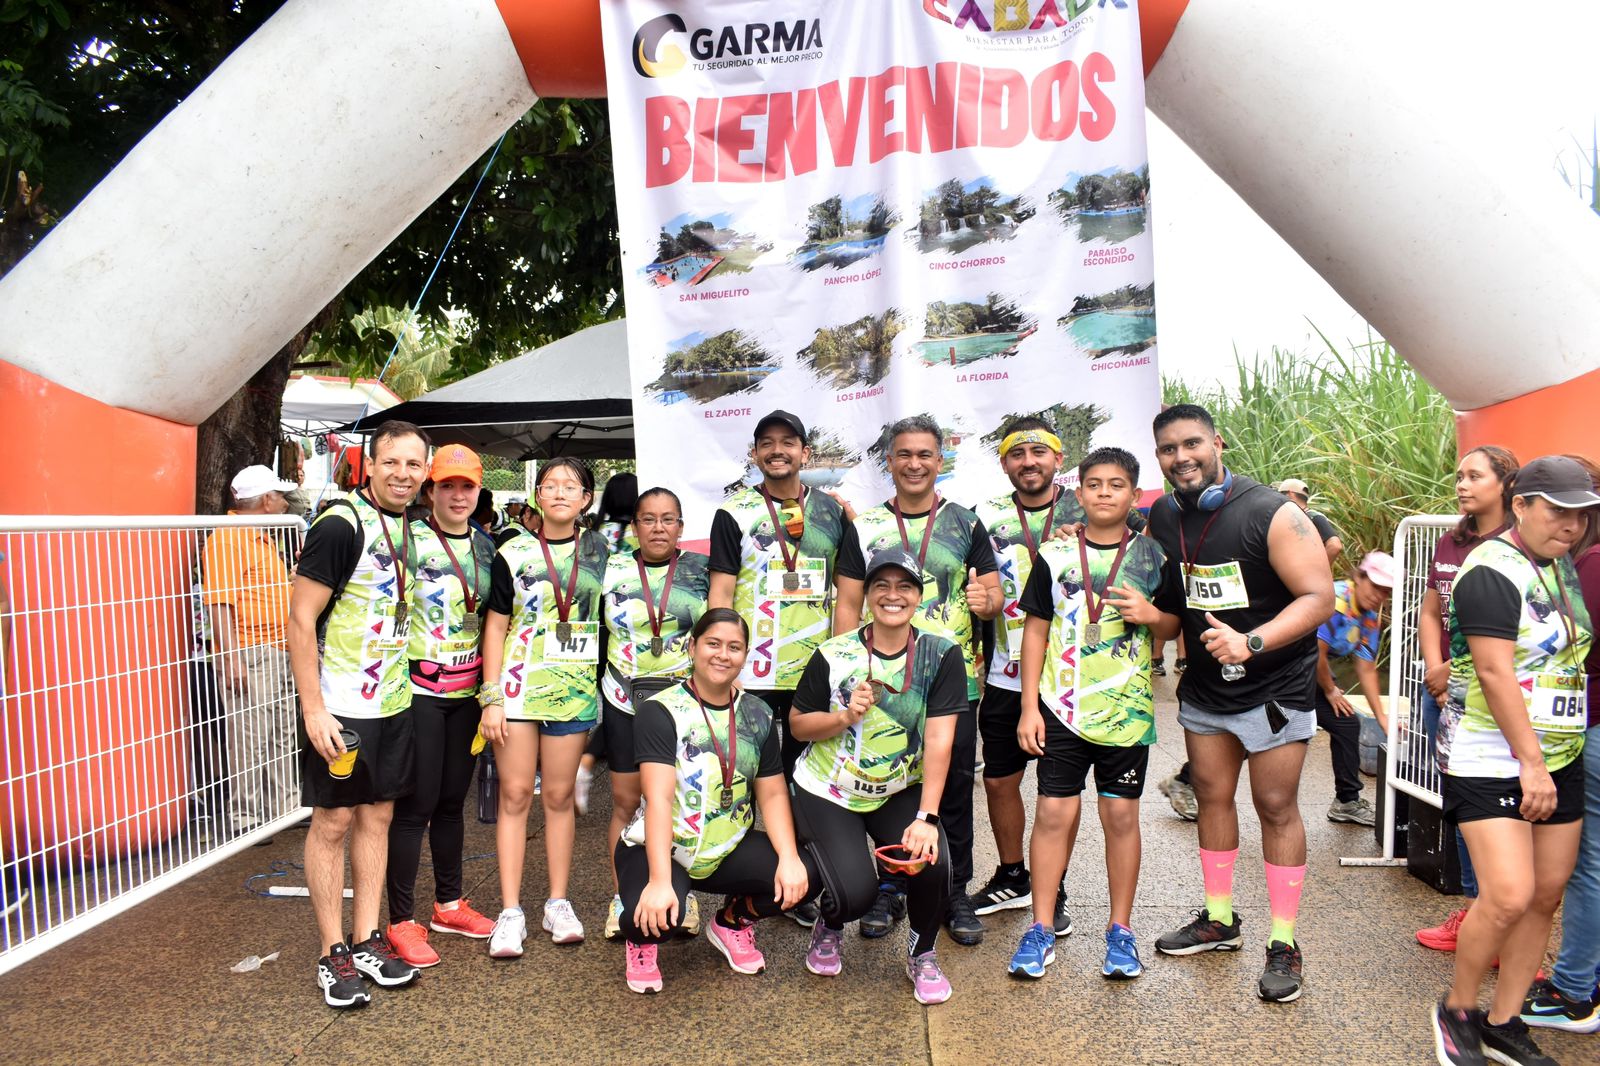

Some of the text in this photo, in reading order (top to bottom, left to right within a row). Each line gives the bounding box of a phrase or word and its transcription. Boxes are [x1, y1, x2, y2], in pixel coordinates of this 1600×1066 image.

[690, 18, 823, 61] GARMA
[965, 34, 1022, 45] BIENESTAR
[1027, 34, 1058, 44] PARA
[693, 51, 823, 71] TU SEGURIDAD AL MEJOR PRECIO
[645, 52, 1116, 188] BIENVENIDOS
[1088, 246, 1127, 258] PARAISO
[929, 256, 1006, 270] CINCO CHORROS
[1083, 253, 1135, 266] ESCONDIDO
[824, 267, 882, 286] PANCHO LÓPEZ
[679, 288, 749, 302] SAN MIGUELITO
[1090, 356, 1151, 372] CHICONAMEL
[956, 371, 1009, 383] LA FLORIDA
[836, 392, 853, 403] LOS
[704, 407, 751, 419] EL ZAPOTE
[1195, 581, 1223, 598] 150
[560, 637, 588, 653] 147
[452, 651, 475, 667] 146
[854, 780, 887, 794] 145
